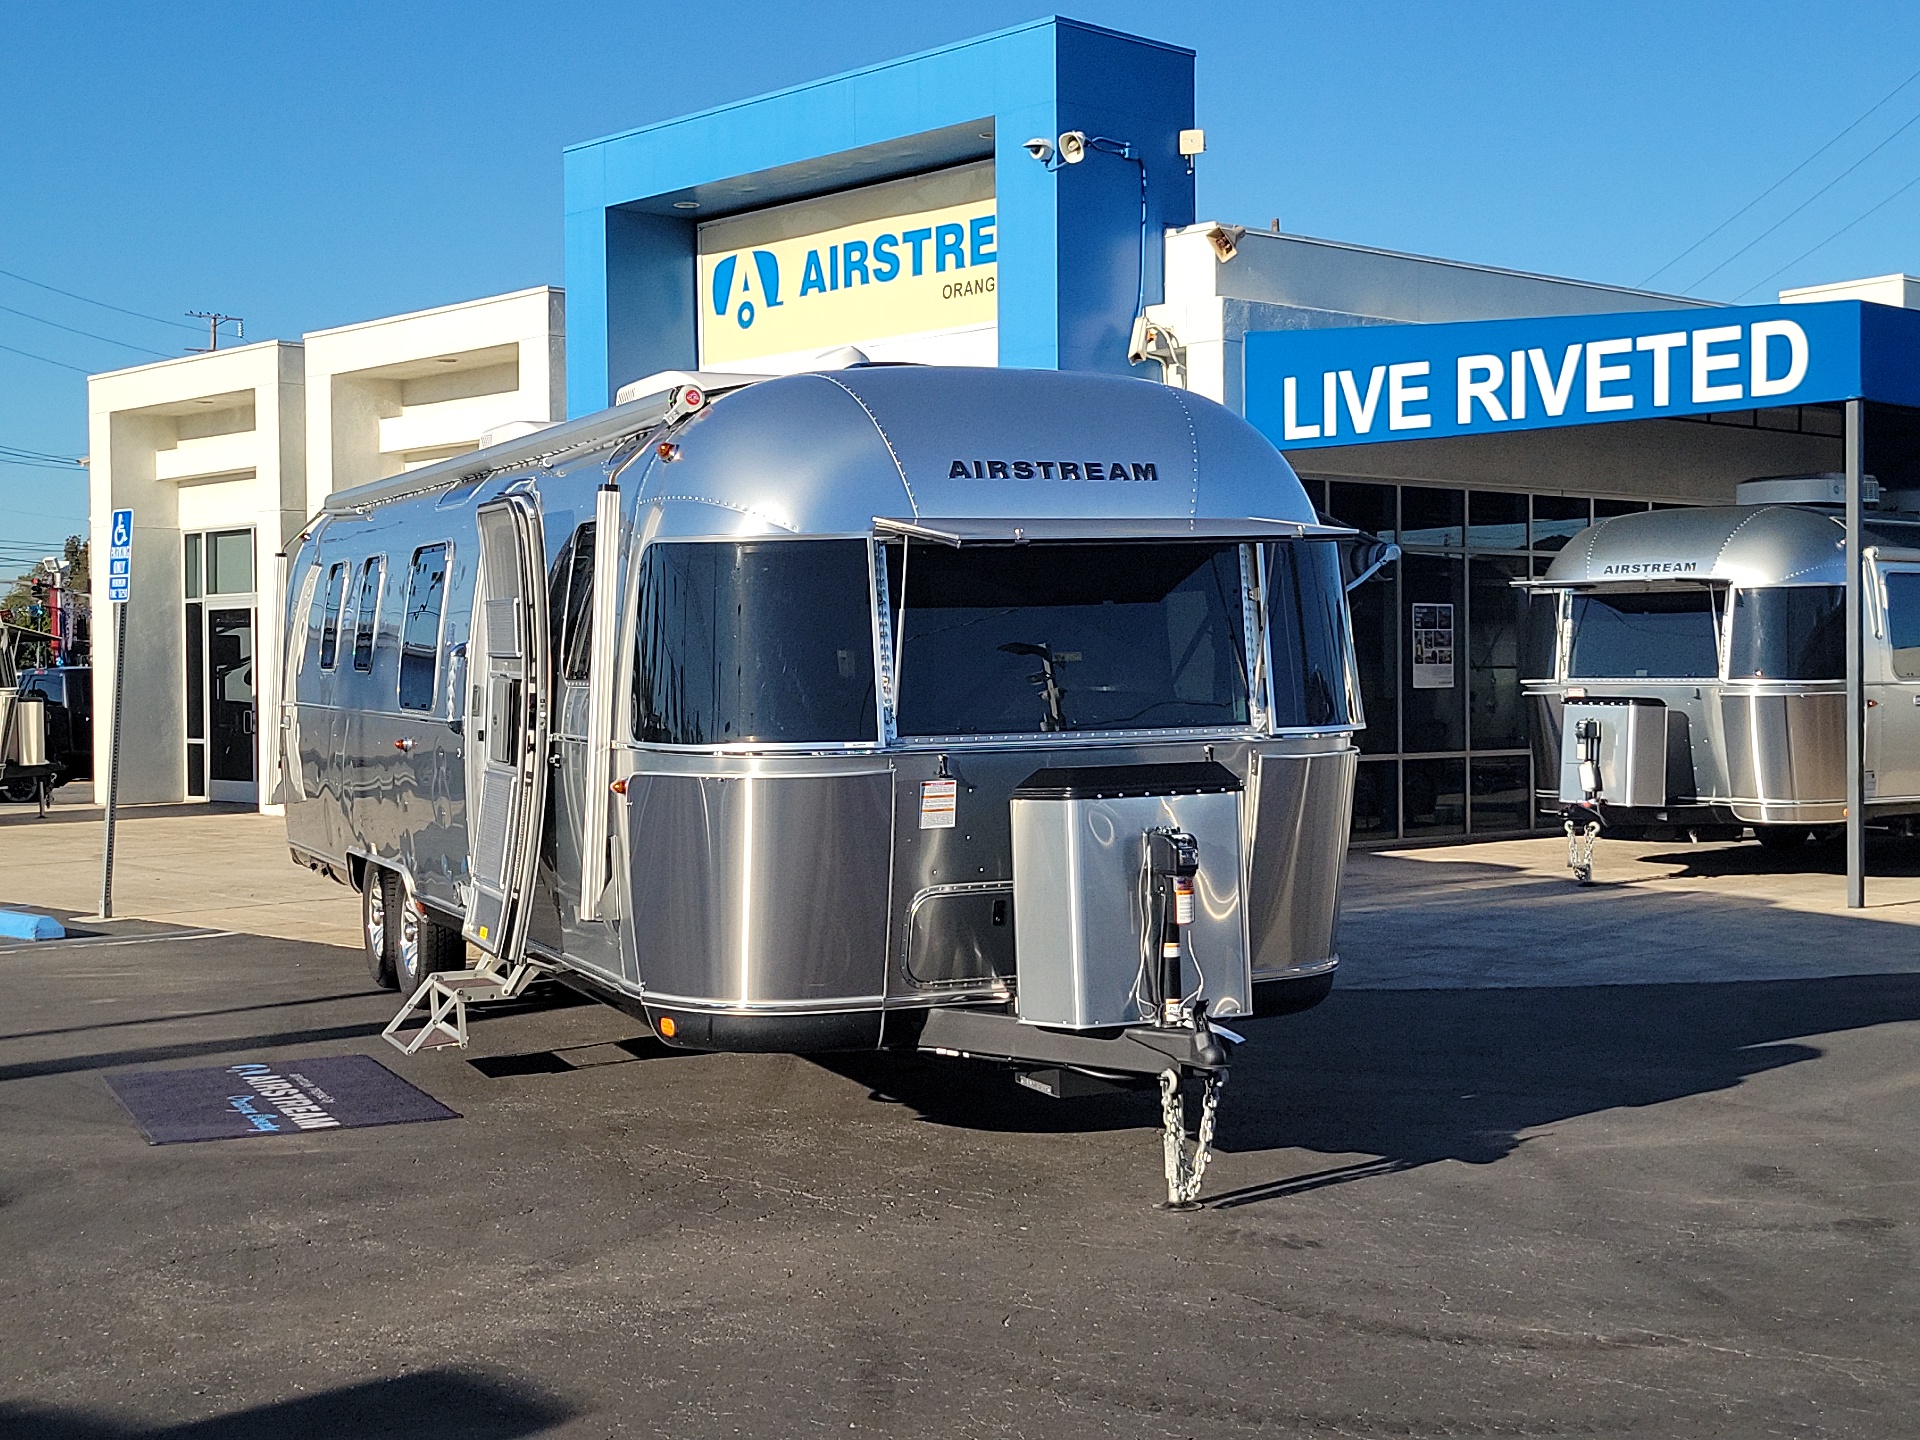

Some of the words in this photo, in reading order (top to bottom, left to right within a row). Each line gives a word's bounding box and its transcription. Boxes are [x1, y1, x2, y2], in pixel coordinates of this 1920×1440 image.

[1283, 361, 1432, 441] LIVE
[1456, 319, 1810, 426] RIVETED
[948, 460, 1159, 481] AIRSTREAM
[1603, 562, 1697, 575] AIRSTREAM
[242, 1074, 341, 1129] AIRSTREAM
